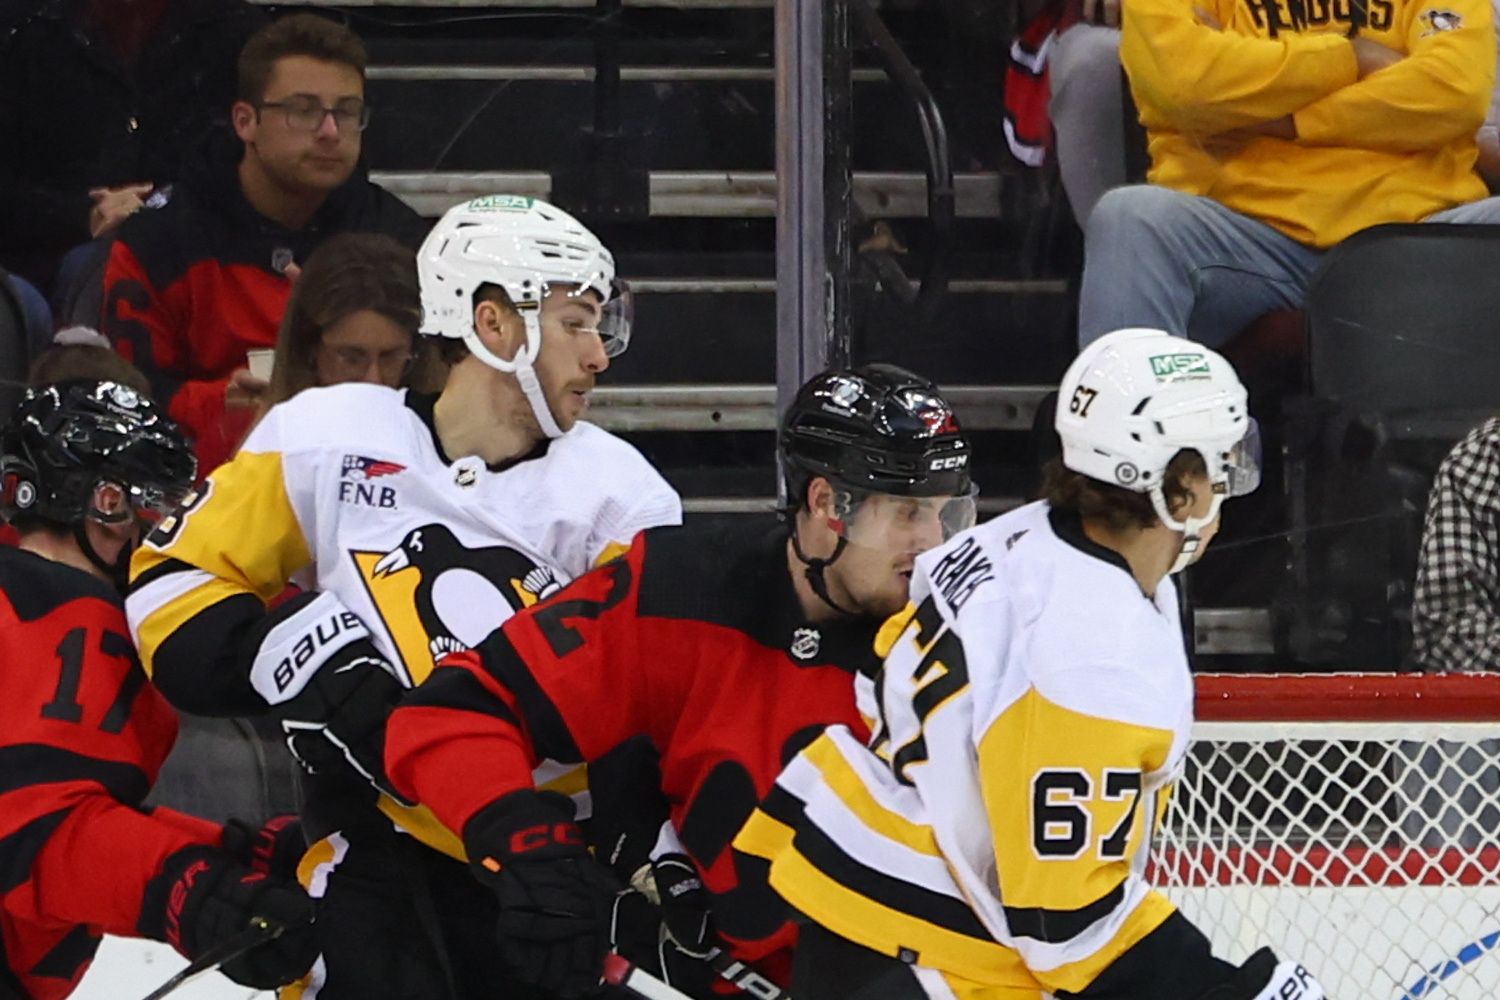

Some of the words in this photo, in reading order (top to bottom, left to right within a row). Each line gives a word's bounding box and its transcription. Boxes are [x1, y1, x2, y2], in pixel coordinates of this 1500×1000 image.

[1069, 384, 1099, 418] 67
[929, 454, 968, 471] CCM
[40, 626, 150, 736] 17
[1030, 766, 1143, 862] 67
